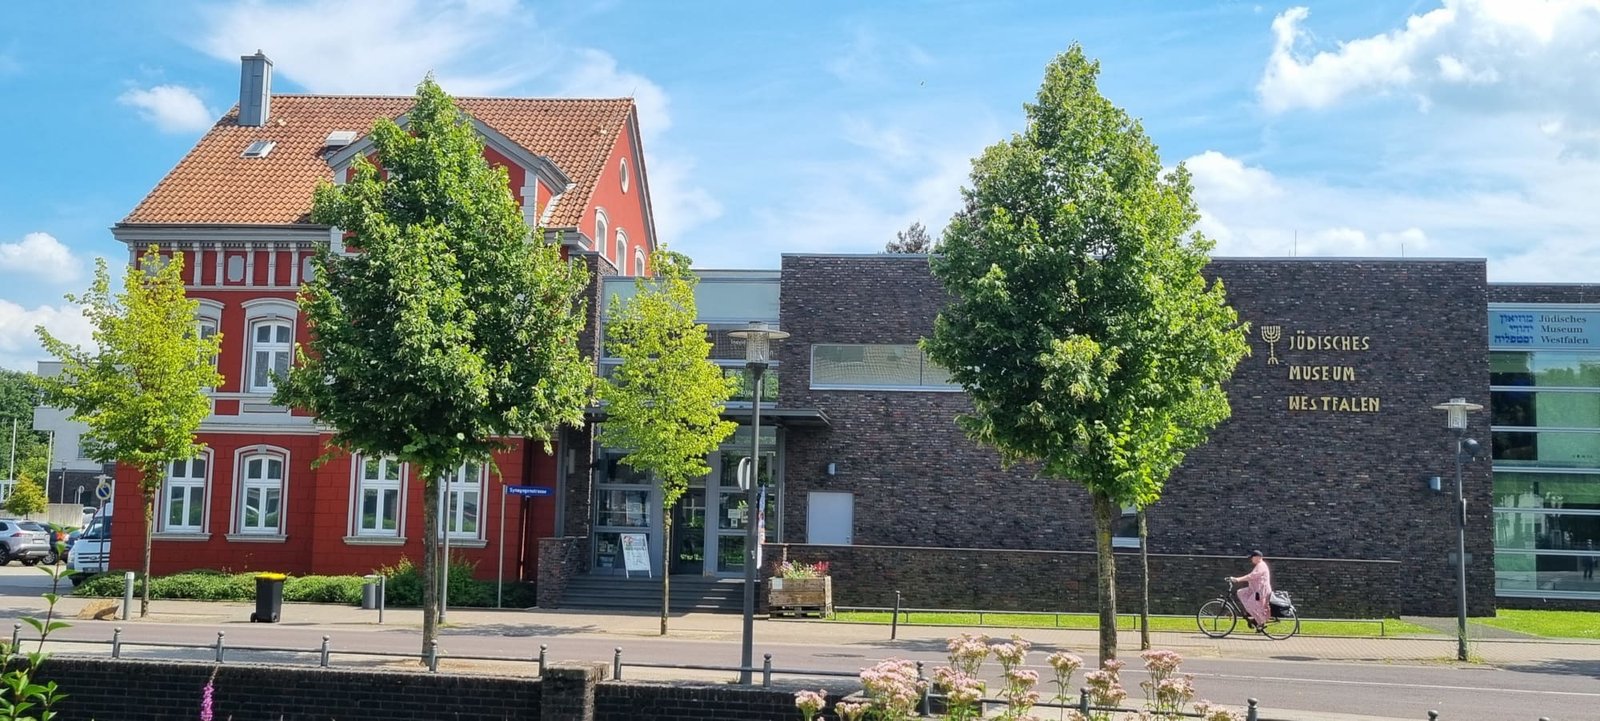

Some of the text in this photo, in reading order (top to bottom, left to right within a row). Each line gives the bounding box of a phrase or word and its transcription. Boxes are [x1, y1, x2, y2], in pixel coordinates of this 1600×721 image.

[1539, 314, 1587, 323] Jüdisches
[1541, 325, 1583, 333] Museum
[1289, 330, 1370, 351] JÜDISCHES
[1541, 335, 1589, 344] Westfalen
[1289, 365, 1355, 381] MUSEUM
